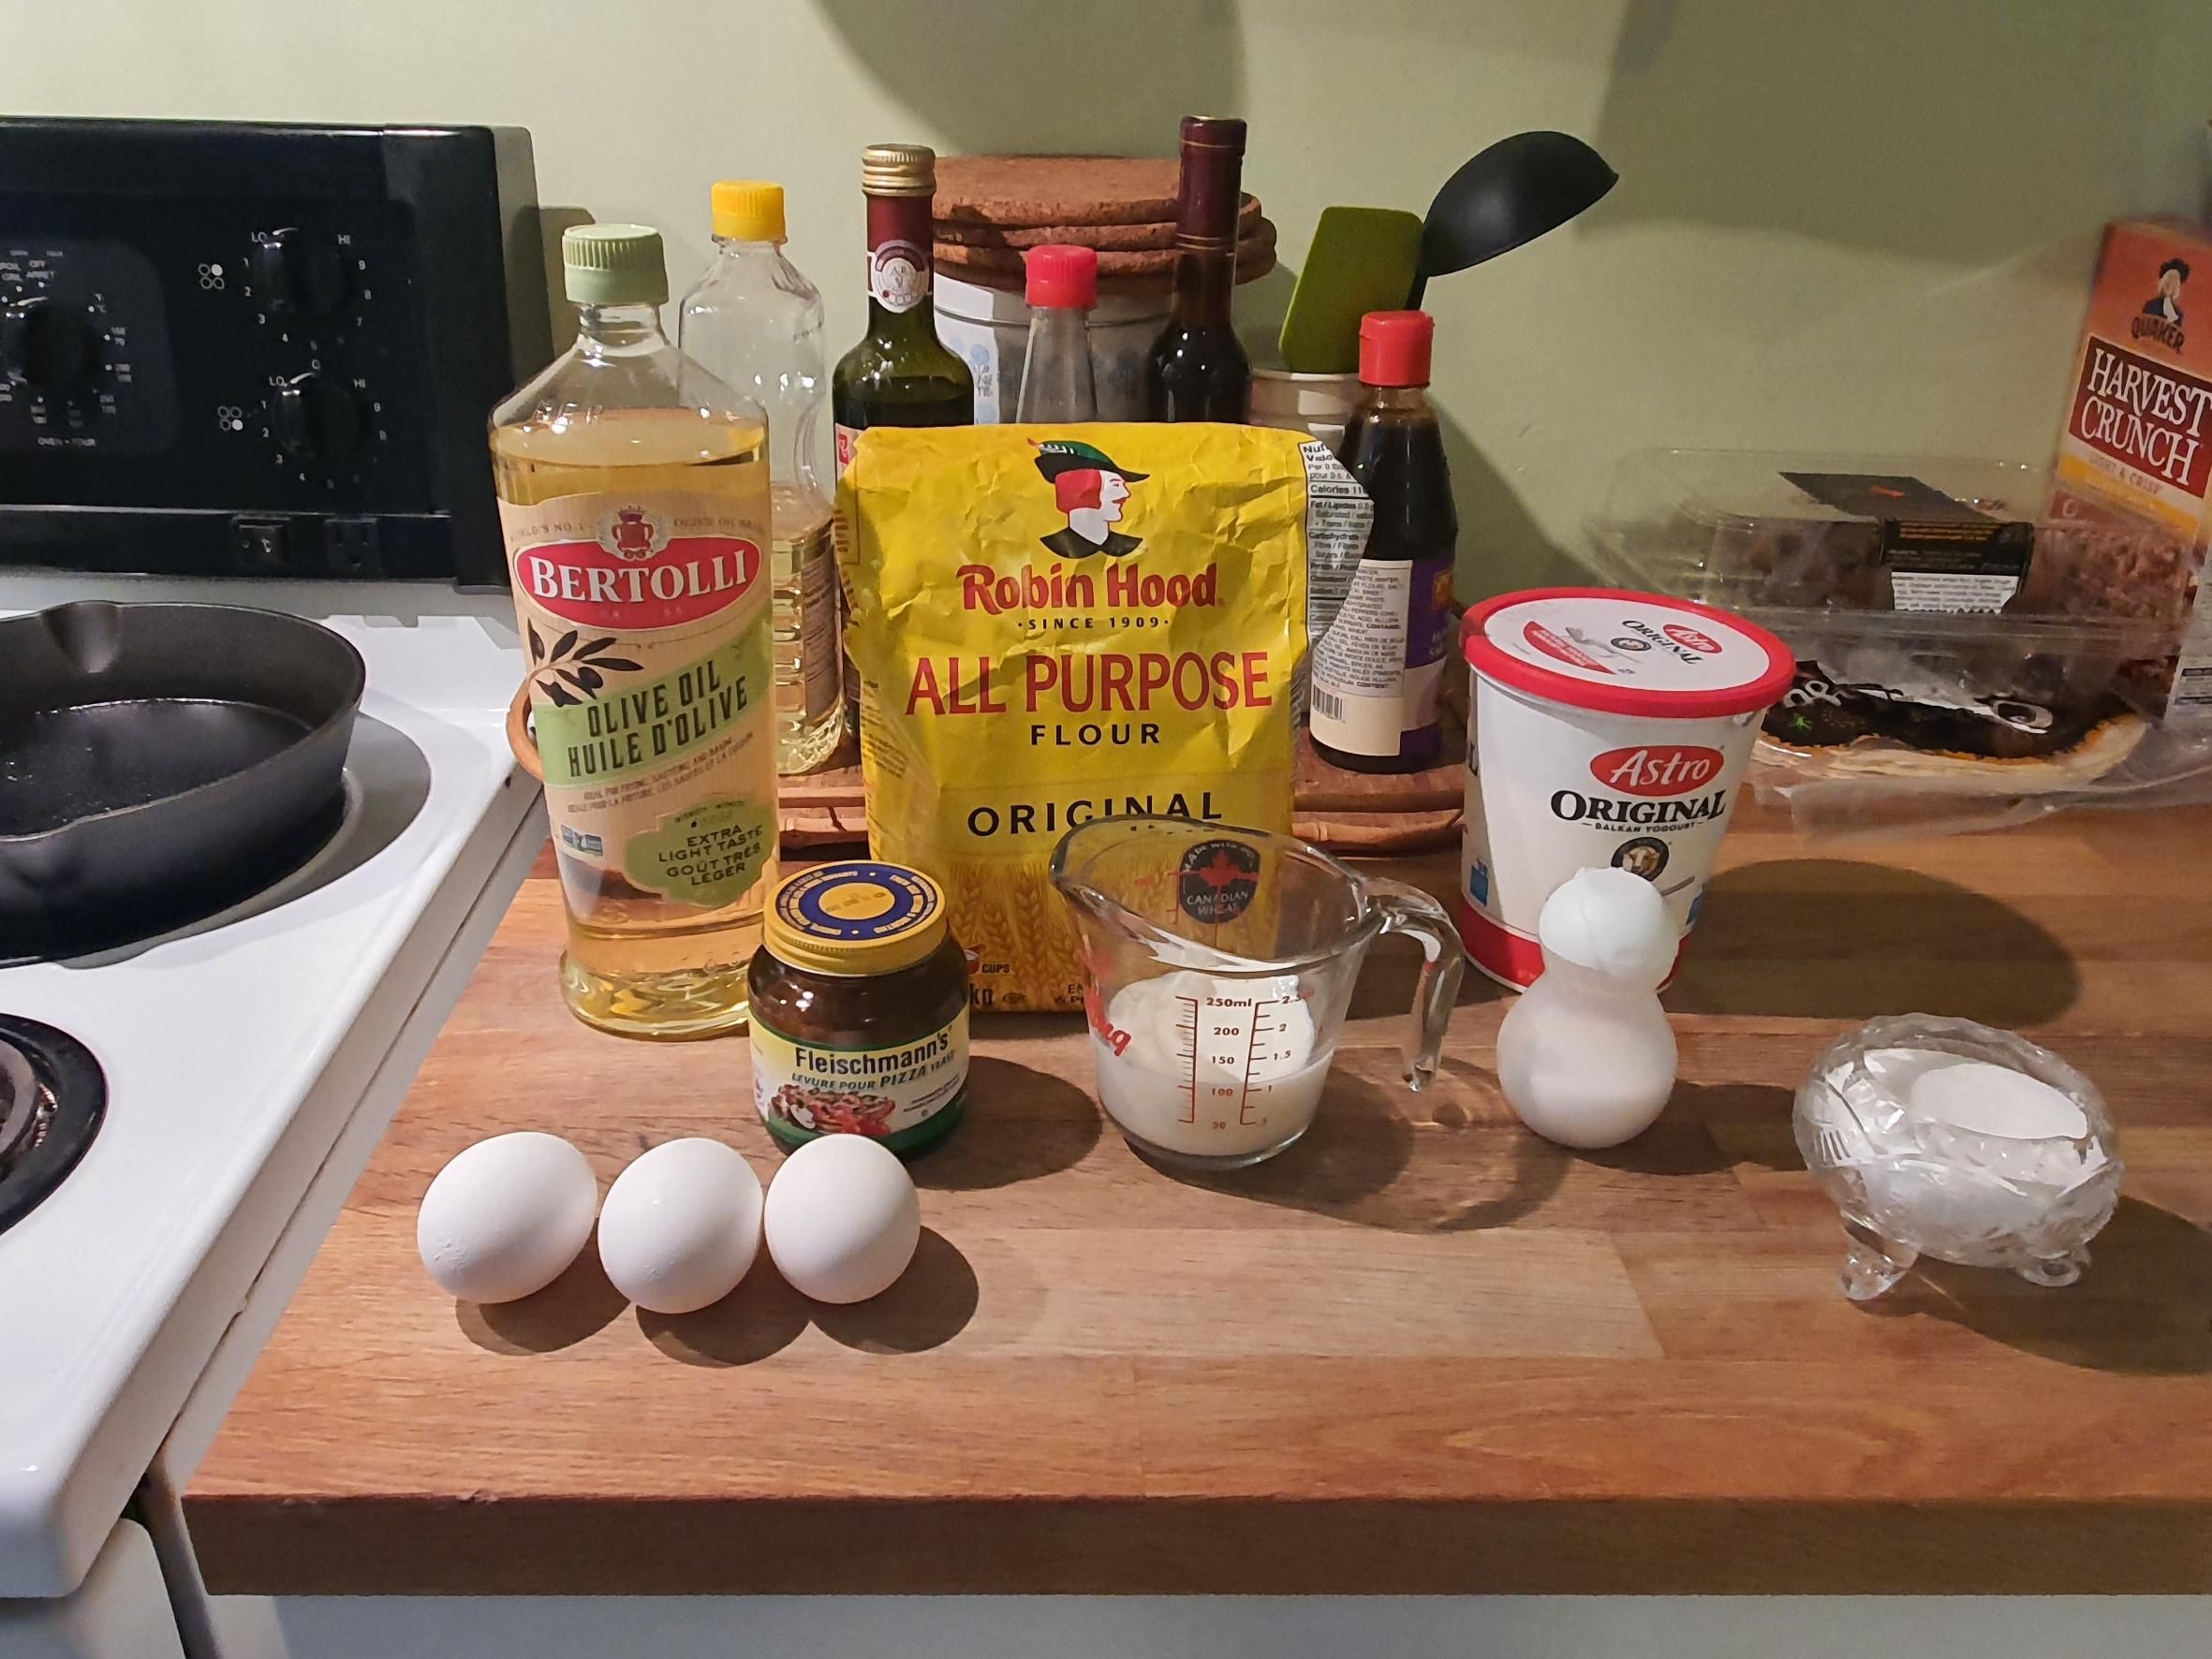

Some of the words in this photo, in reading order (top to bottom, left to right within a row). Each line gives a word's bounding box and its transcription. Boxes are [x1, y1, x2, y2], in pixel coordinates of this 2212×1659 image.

[338, 233, 351, 245] HI
[244, 286, 252, 297] 2
[2131, 316, 2186, 354] QUAKER
[353, 378, 367, 389] HI
[2087, 347, 2212, 437] HARVEST
[262, 427, 270, 438] 2
[2081, 395, 2200, 487] CRUNCH
[1310, 484, 1349, 494] Calories
[529, 549, 747, 603] BERTOLLI
[955, 562, 1095, 615] Robin
[1106, 562, 1217, 608] Hood
[1028, 618, 1094, 630] SINCE
[1109, 617, 1159, 628] 1909
[1622, 620, 1706, 665] ORIGINAL
[1667, 627, 1717, 652] Astro
[905, 656, 1007, 716] ALL
[1026, 651, 1274, 712] PURPOSE
[586, 683, 670, 738] OLIVE
[678, 659, 721, 708] OIL
[568, 731, 643, 778] HUILE
[651, 674, 749, 756] D'OLIVE
[1031, 722, 1161, 746] FLOUR
[1609, 749, 1711, 787] Astro
[967, 791, 1222, 837] ORIGINAL
[1551, 789, 1727, 824] ORIGINAL
[658, 844, 712, 862] LIGHT
[716, 825, 763, 851] TASTE
[686, 825, 743, 847] EXTRA
[981, 963, 1010, 974] CUPS
[1205, 997, 1252, 1007] 250ml
[1213, 1026, 1240, 1036] 200
[1278, 1023, 1288, 1033] 2
[795, 1032, 949, 1075] Fleischmann's
[1212, 1056, 1235, 1064] 150
[1274, 1050, 1291, 1061] 1.5
[791, 1072, 835, 1090] LEVURE
[838, 1080, 877, 1091] POUR
[878, 1065, 926, 1087] PIZZA
[1211, 1087, 1233, 1097] 100
